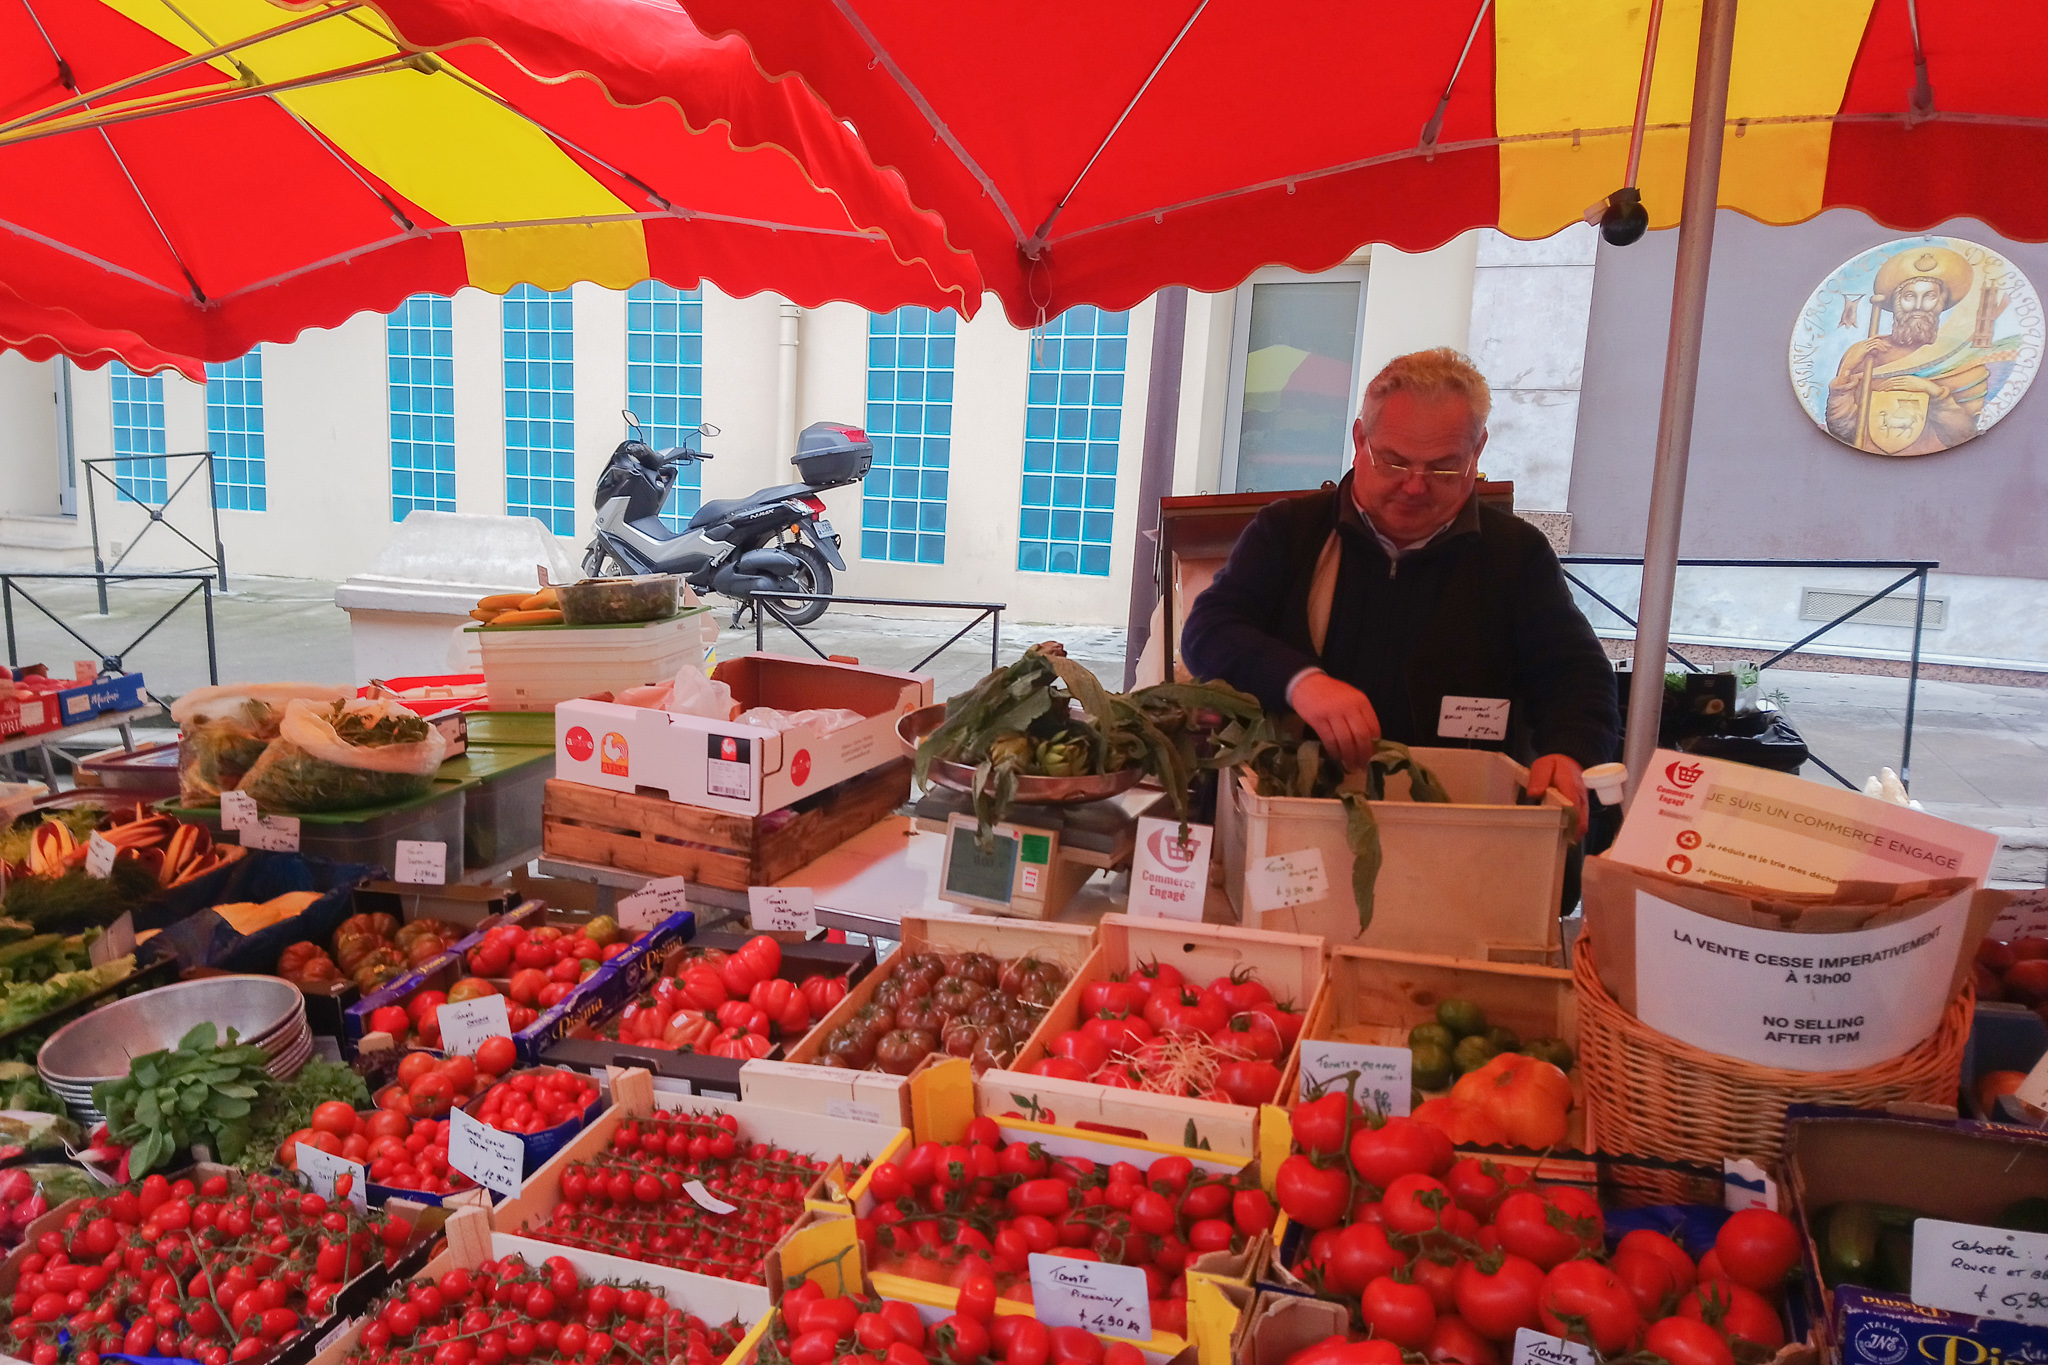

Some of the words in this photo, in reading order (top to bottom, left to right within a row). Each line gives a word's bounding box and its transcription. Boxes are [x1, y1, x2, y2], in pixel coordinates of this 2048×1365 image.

[1656, 785, 1695, 799] Commerce
[1707, 792, 1722, 805] JE
[1729, 796, 1761, 812] SUIS
[1766, 805, 1790, 820] UN
[1794, 813, 1884, 847] COMMERCE
[1889, 840, 1958, 870] ENGAGÉ
[1705, 842, 1716, 850] Je
[1718, 845, 1745, 858] réduis
[1748, 853, 1757, 861] et
[1759, 856, 1769, 865] je
[1770, 859, 1786, 870] trie
[1787, 865, 1807, 876] mes
[1808, 870, 1839, 885] déche
[1142, 870, 1196, 889] Commerce
[1149, 885, 1185, 903] Engagé
[1674, 929, 1692, 944] LA
[1696, 937, 1750, 962] VENTE
[1754, 953, 1814, 969] CESSE
[1819, 926, 1942, 969] IMPERATIVEMENT
[1785, 970, 1798, 984] À
[1804, 972, 1852, 985] 13h00
[1763, 1015, 1789, 1029] NO
[1794, 1015, 1865, 1030] SELLING
[1764, 1031, 1821, 1045] AFTER
[1828, 1031, 1860, 1044] 1PM
